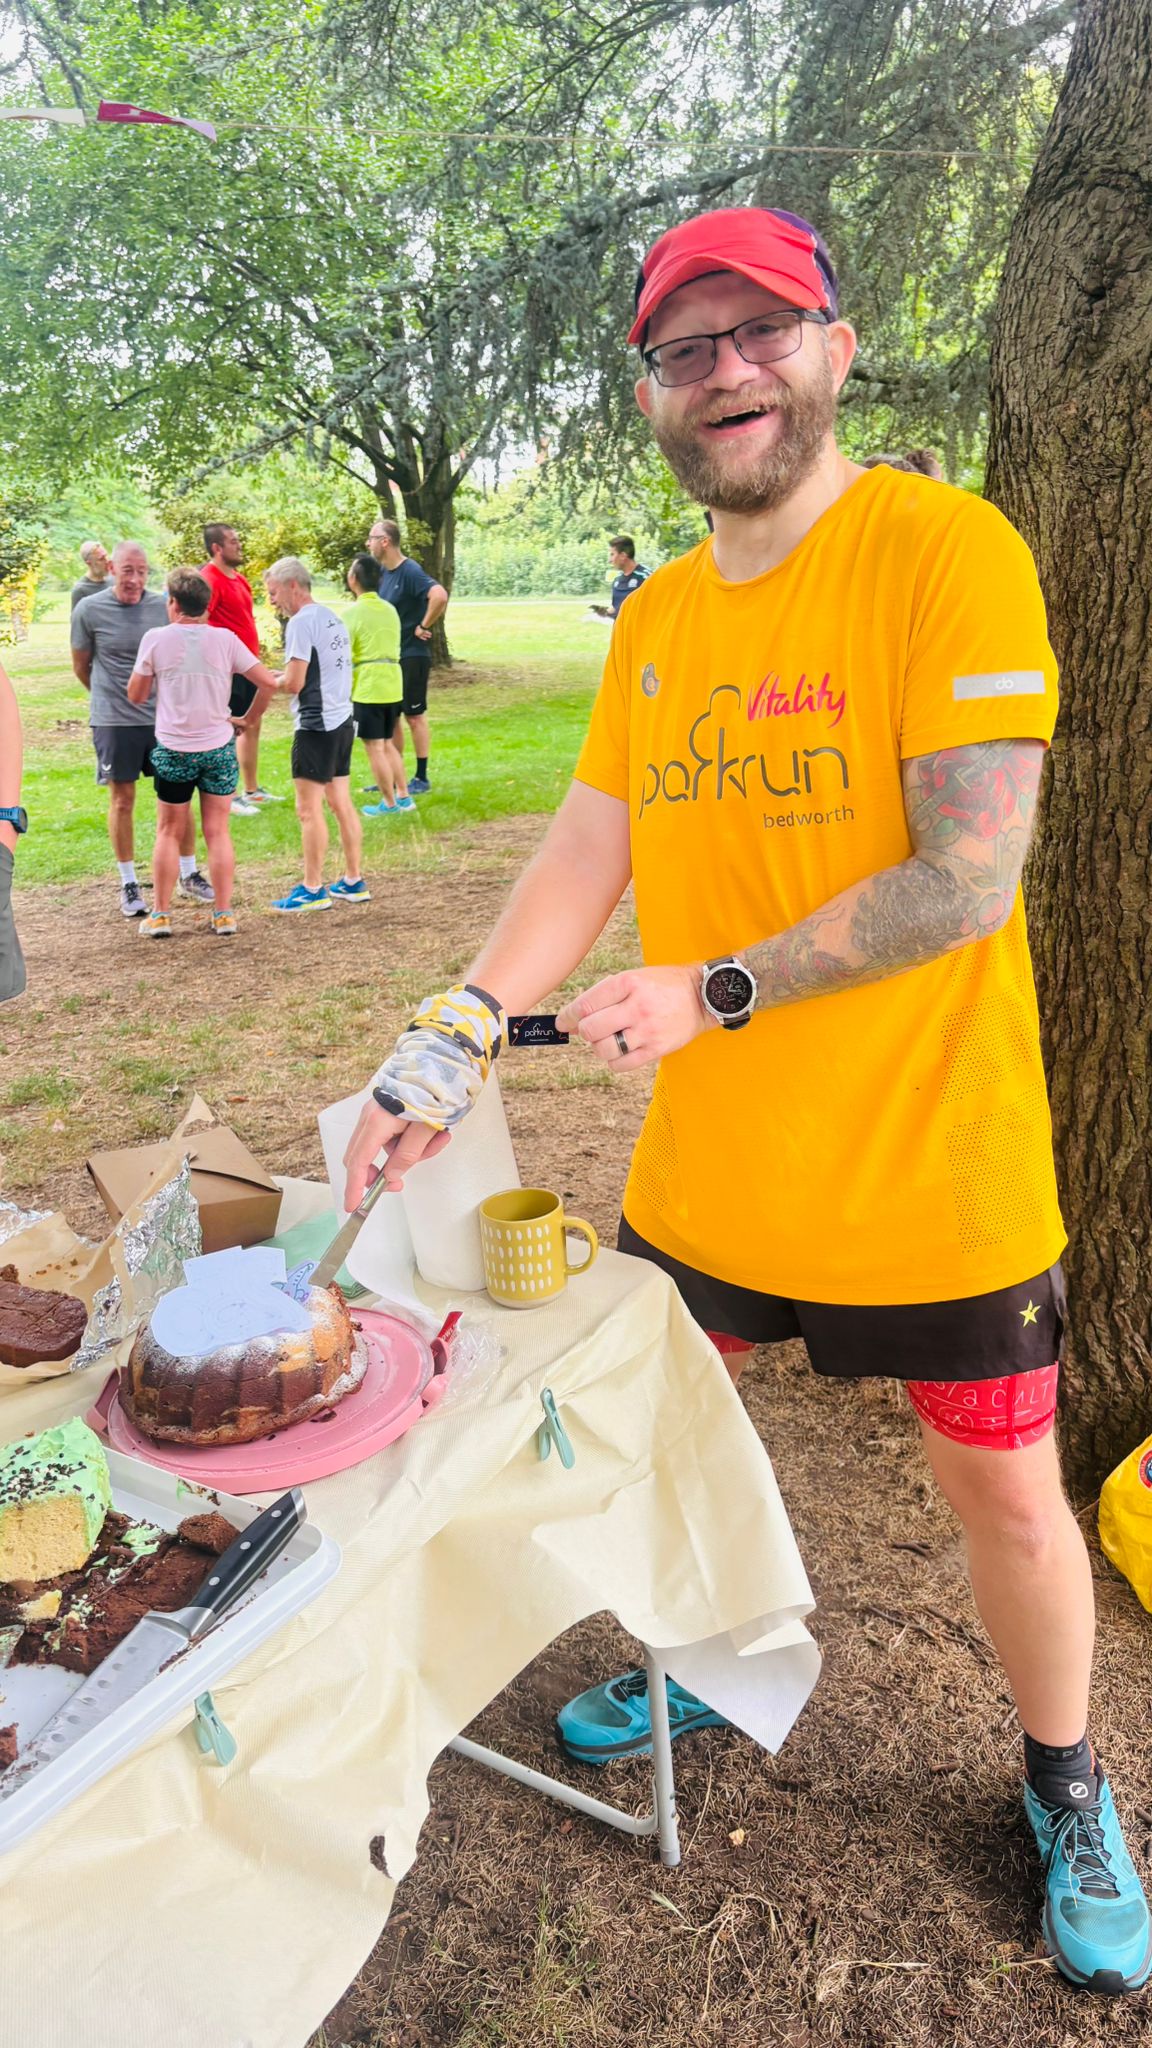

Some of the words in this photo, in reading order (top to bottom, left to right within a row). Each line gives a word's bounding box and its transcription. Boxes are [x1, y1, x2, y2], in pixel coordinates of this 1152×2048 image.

[747, 670, 846, 729] Vitality
[638, 684, 850, 821] parkrun
[763, 805, 855, 829] bedworth
[524, 1022, 554, 1038] parkrun
